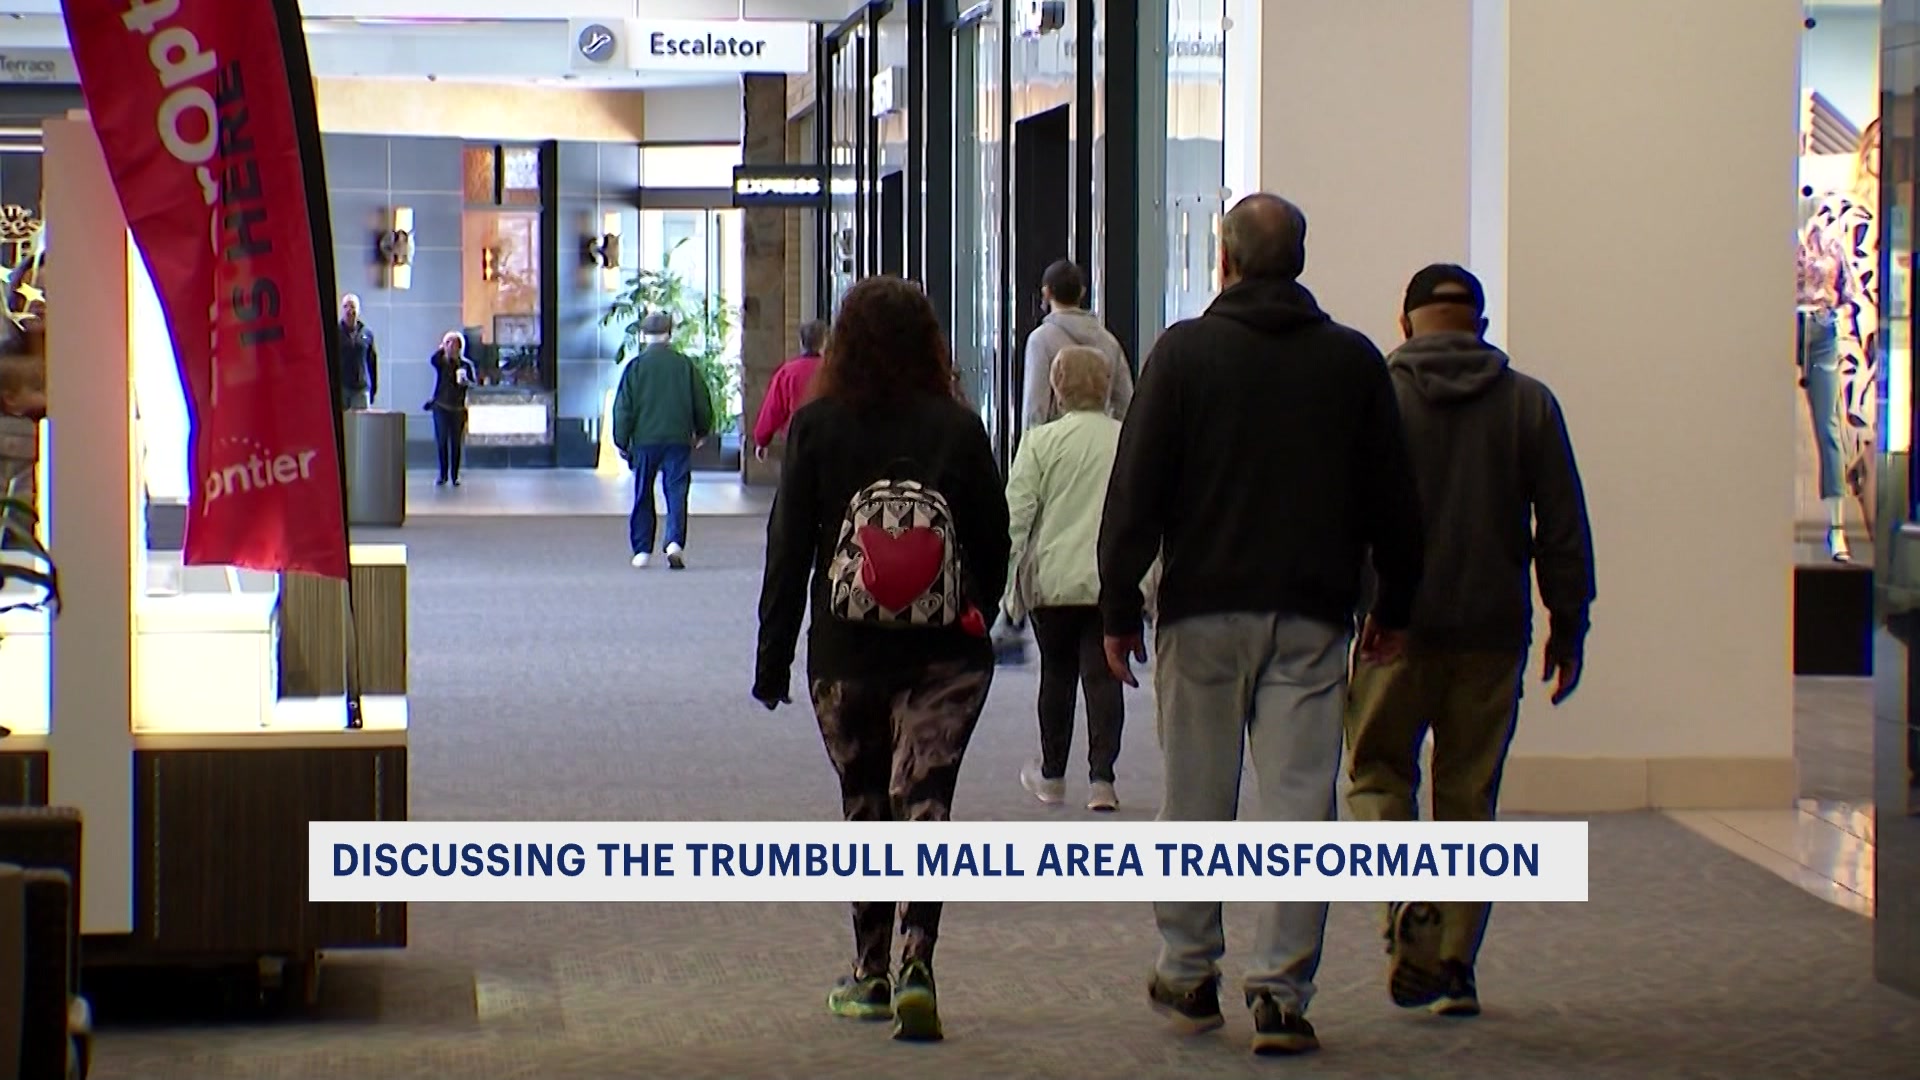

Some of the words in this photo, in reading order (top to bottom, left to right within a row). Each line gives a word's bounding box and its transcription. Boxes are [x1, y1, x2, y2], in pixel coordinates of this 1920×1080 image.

[0, 54, 56, 73] Terrace
[650, 31, 767, 57] Escalator
[217, 59, 273, 262] HERE
[232, 277, 286, 346] IS
